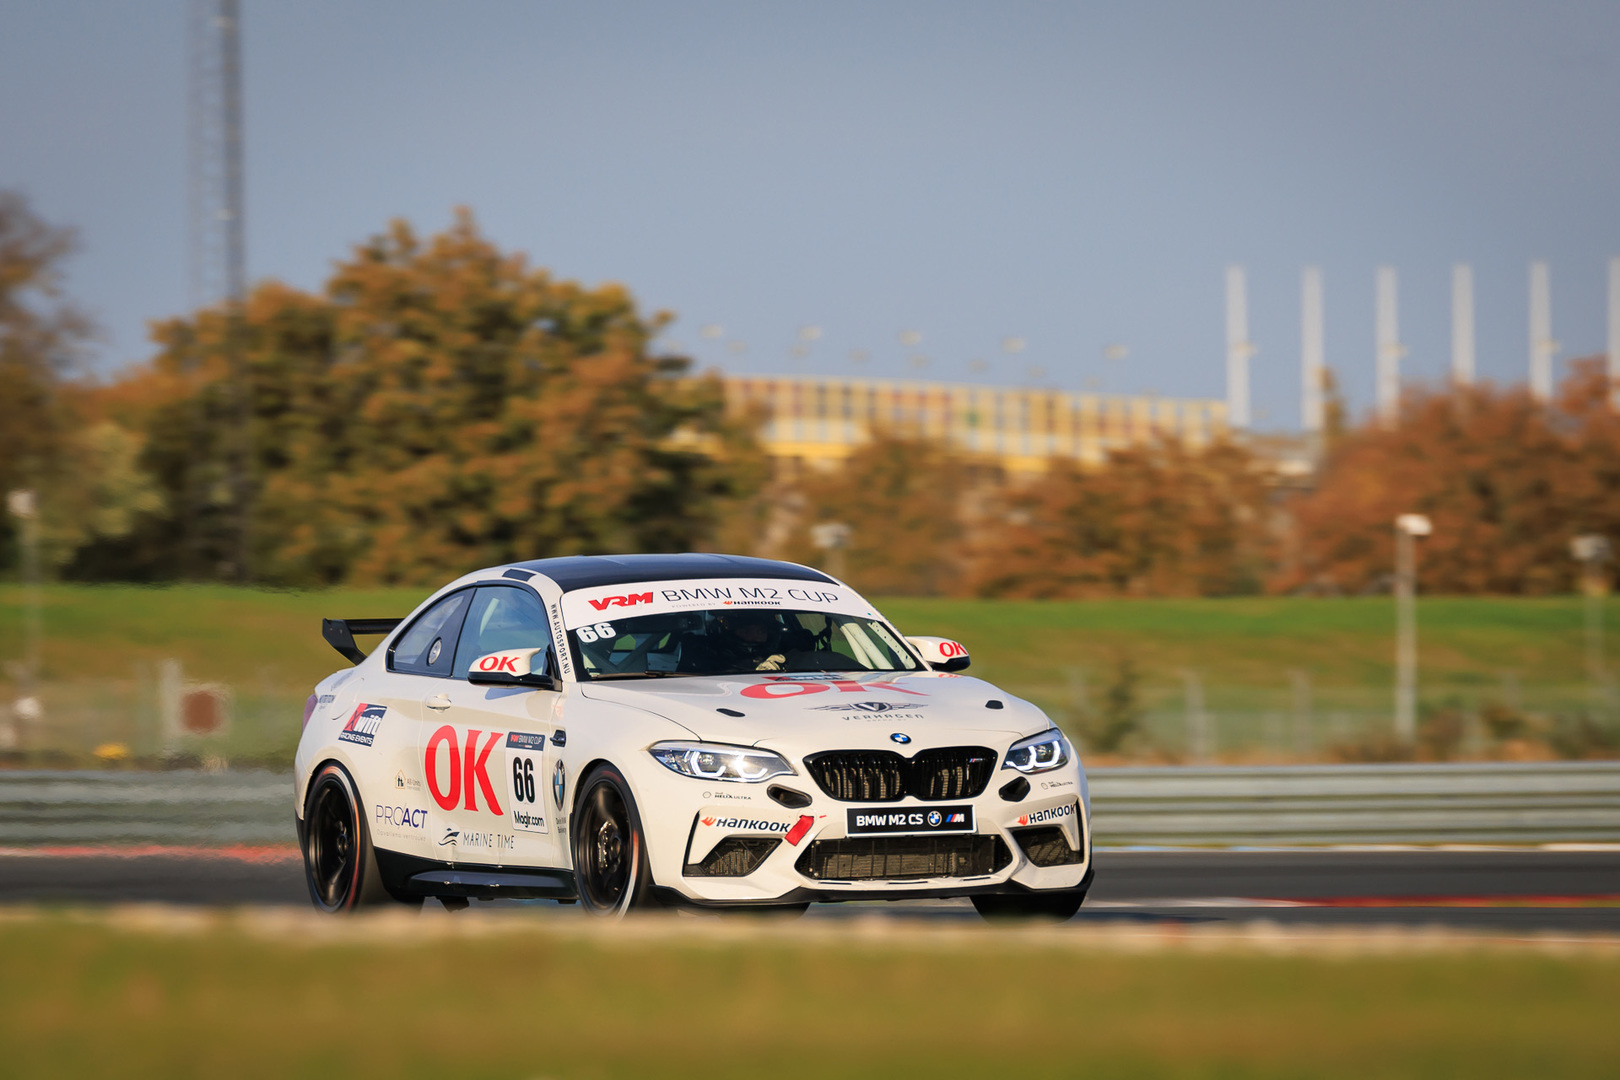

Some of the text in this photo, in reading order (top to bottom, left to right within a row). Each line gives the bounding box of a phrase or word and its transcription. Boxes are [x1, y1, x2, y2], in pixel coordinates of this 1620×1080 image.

[588, 587, 839, 611] VRM BMW M2 CUP
[550, 603, 571, 675] WWW.AUTOSPORT.NU
[575, 622, 617, 643] 66
[939, 641, 968, 657] OK
[479, 656, 521, 673] OK
[740, 680, 931, 699] OK
[425, 725, 504, 816] OK
[513, 756, 535, 804] 66
[856, 813, 924, 826] BMW M2 CS
[463, 832, 515, 849] MARINE TIME
